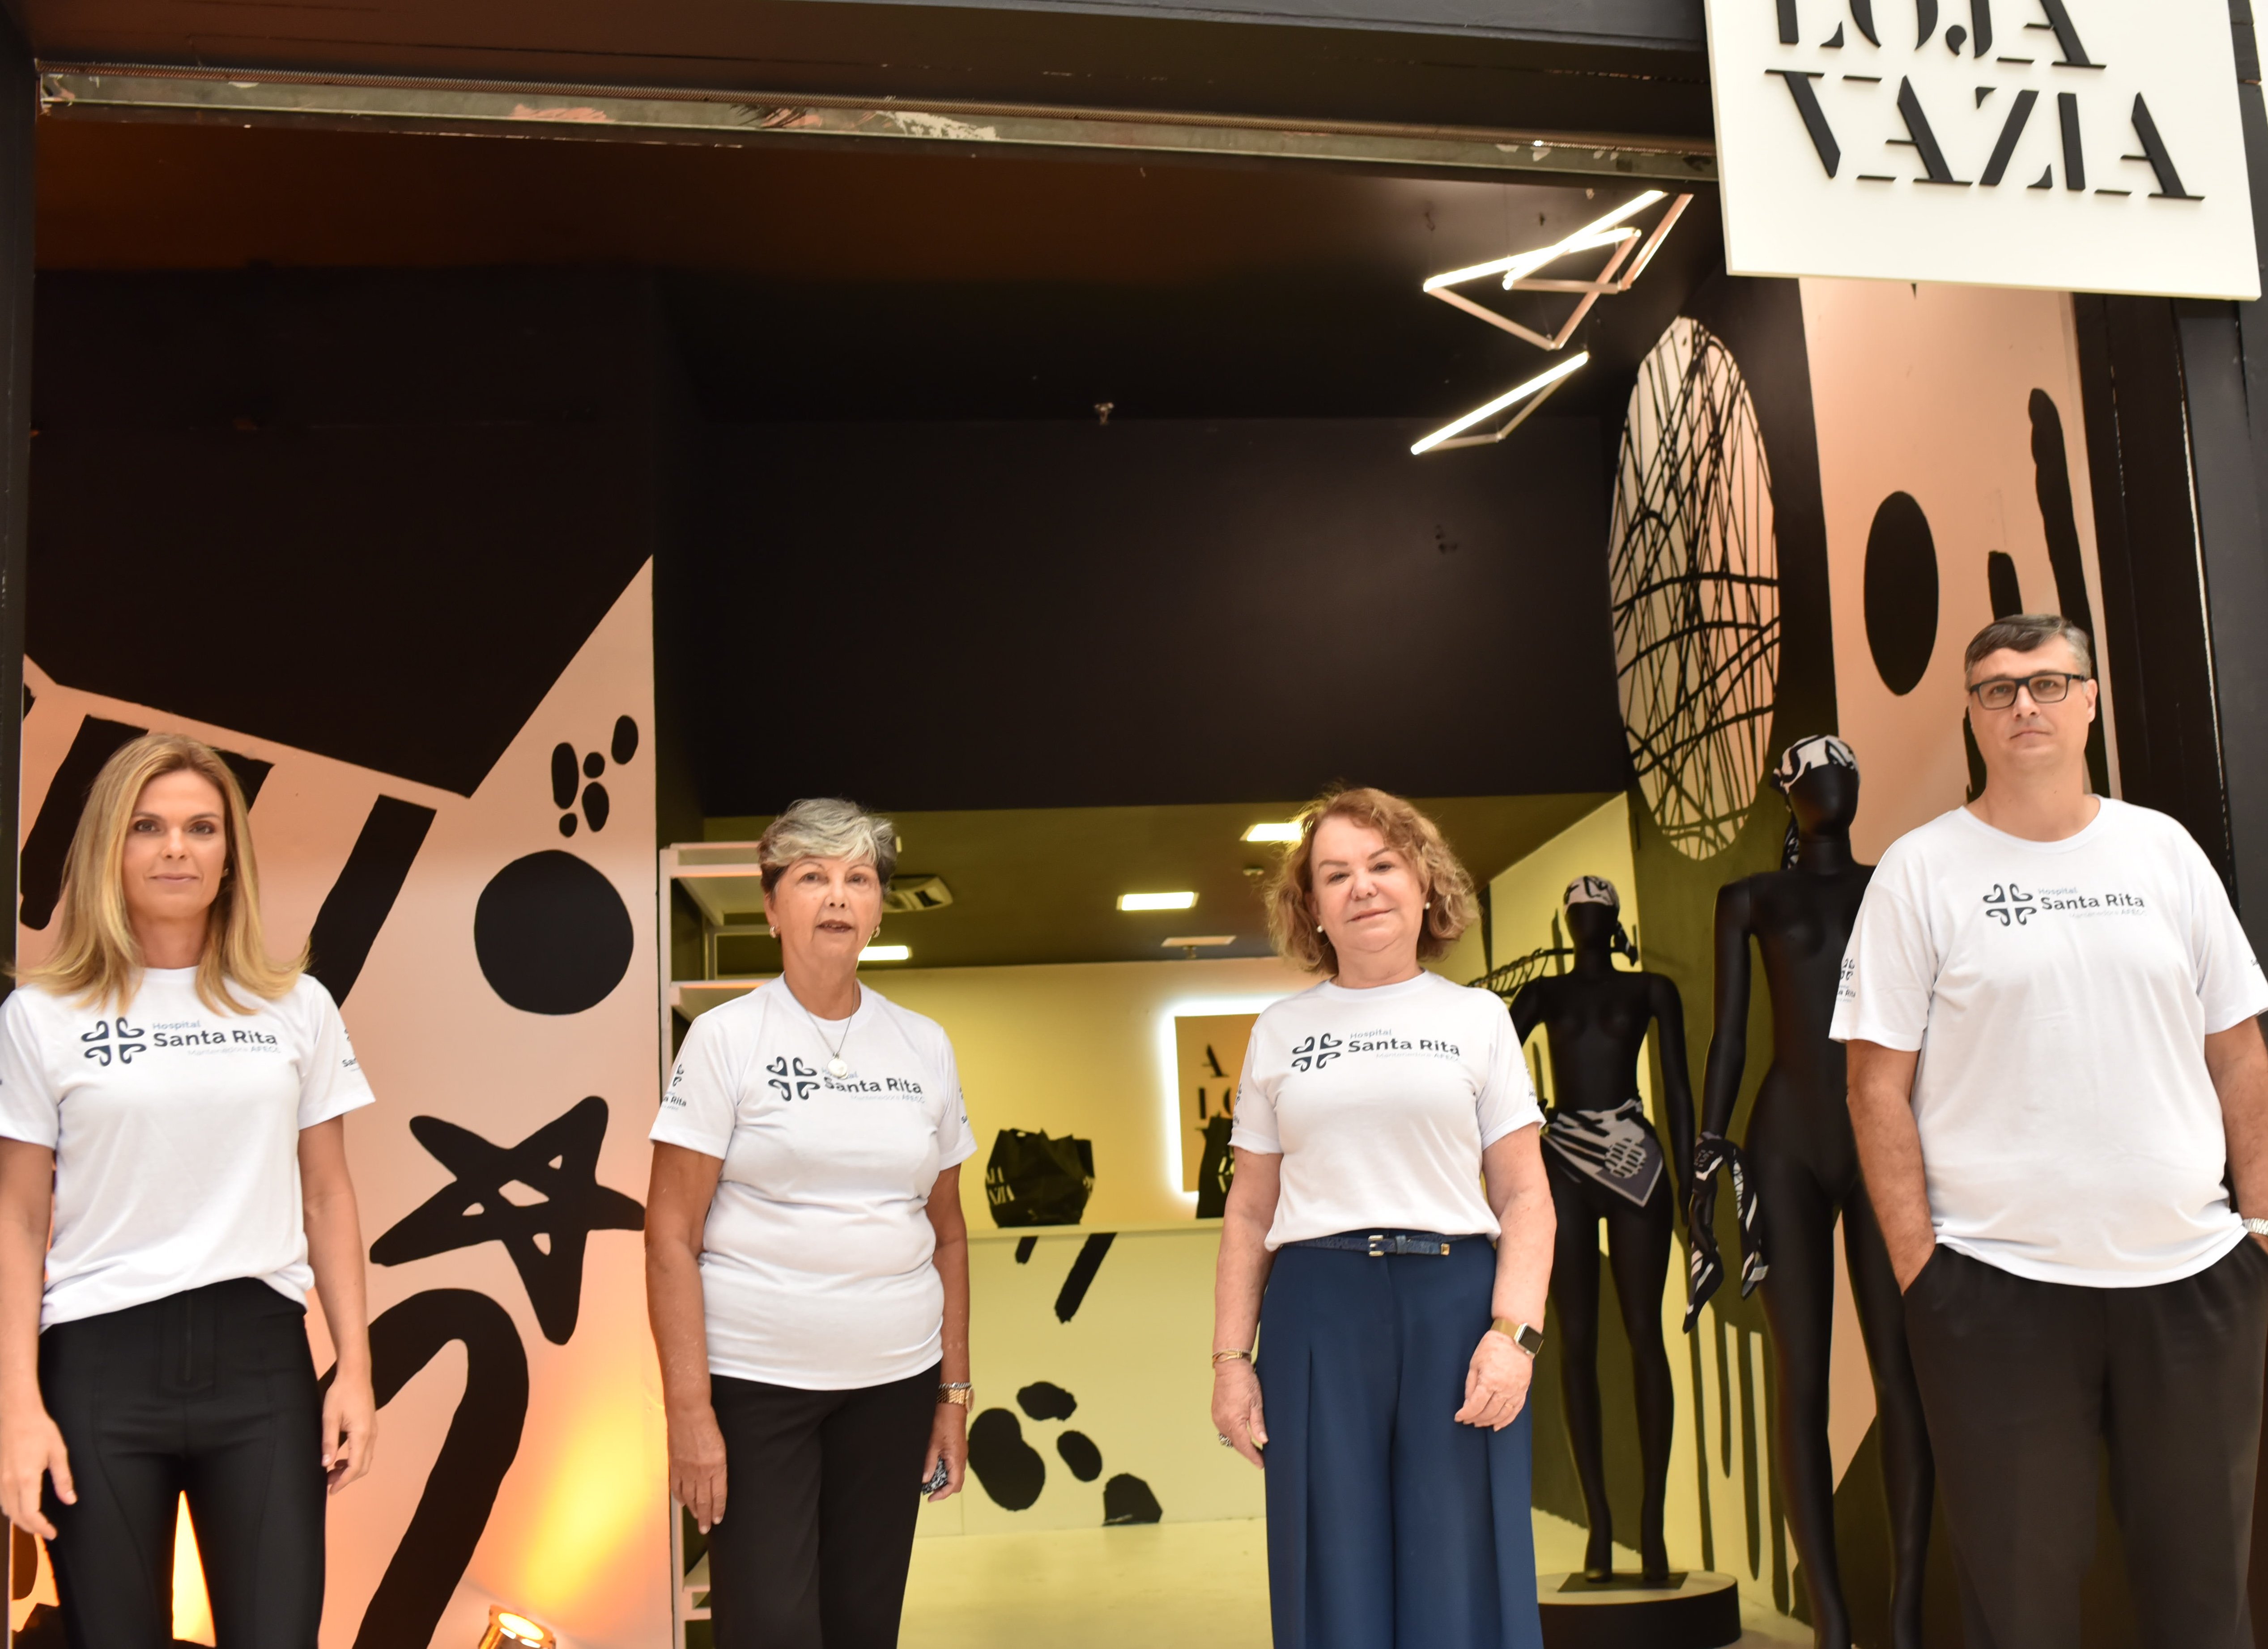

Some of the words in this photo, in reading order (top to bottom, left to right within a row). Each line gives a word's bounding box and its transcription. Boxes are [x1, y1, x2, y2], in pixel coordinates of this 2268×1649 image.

[1765, 69, 2205, 202] VAZIA
[2038, 887, 2078, 896] Hospital
[2041, 896, 2100, 910] Santa
[2105, 893, 2145, 908] Rita
[153, 1020, 200, 1031] Hospital
[1350, 1028, 1392, 1039] Hospital
[153, 1030, 226, 1047] Santa
[232, 1030, 277, 1045] Rita
[1348, 1038, 1413, 1052] Santa
[1420, 1040, 1460, 1056] Rita
[824, 1077, 881, 1092] Santa
[886, 1078, 923, 1094] Rita
